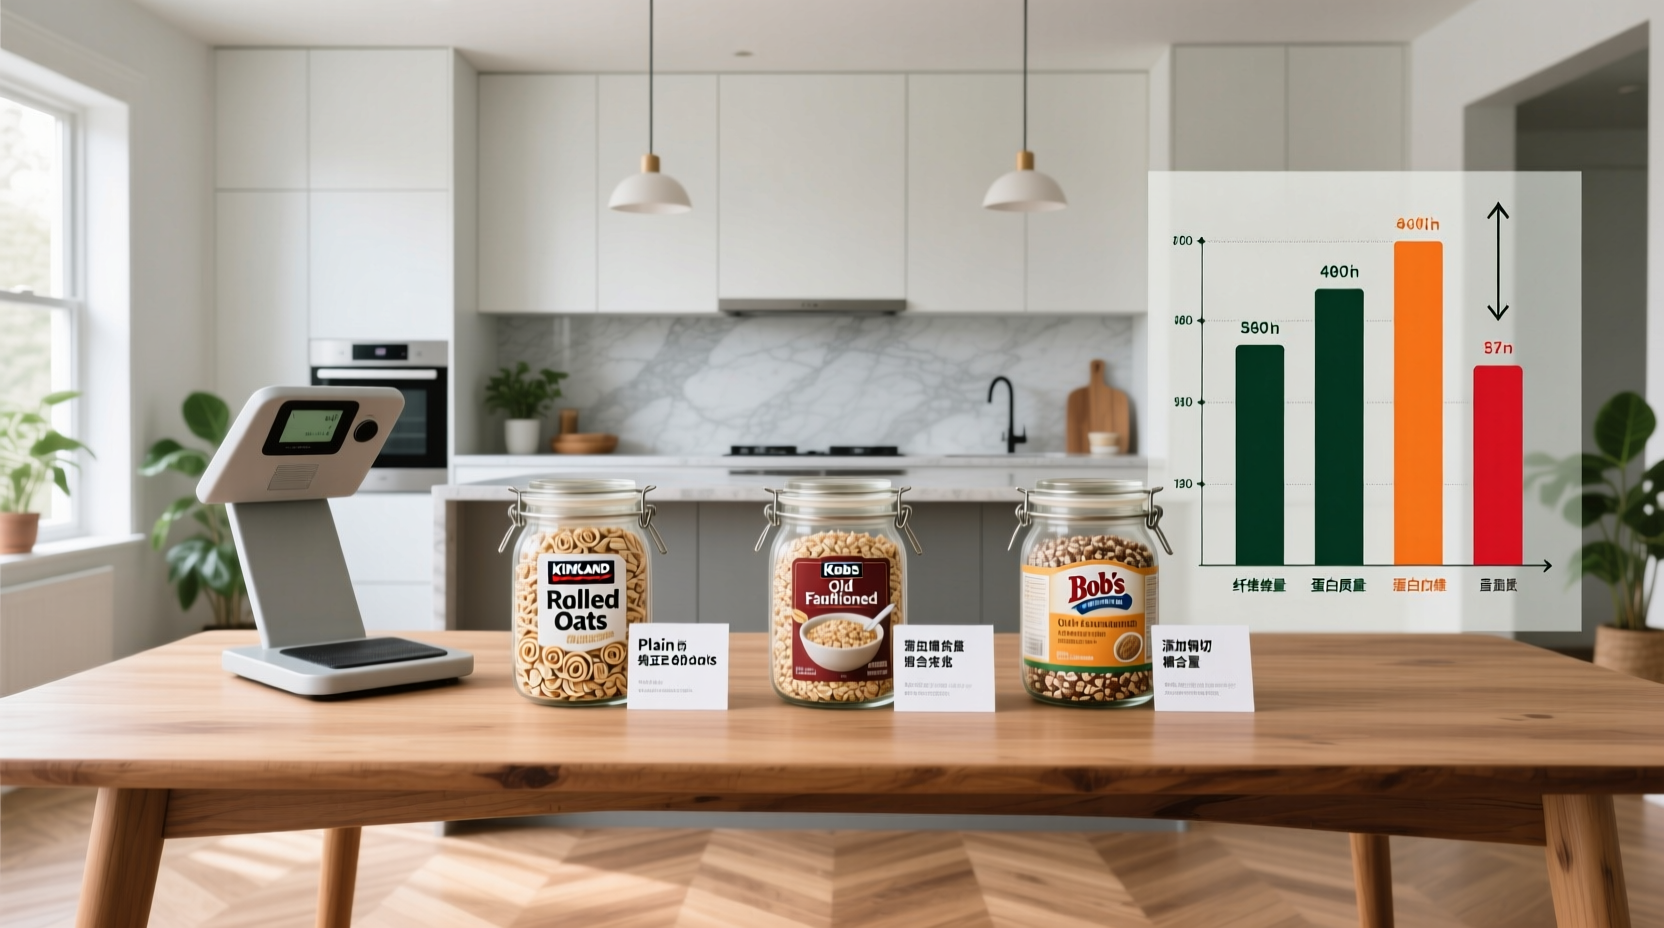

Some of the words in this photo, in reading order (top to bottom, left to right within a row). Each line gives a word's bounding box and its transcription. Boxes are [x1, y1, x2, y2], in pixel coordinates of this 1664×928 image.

[828, 578, 854, 593] Old
[1068, 571, 1126, 604] Bob's
[547, 588, 620, 610] Rolled
[554, 611, 608, 631] Oats
[638, 637, 675, 652] Plain
